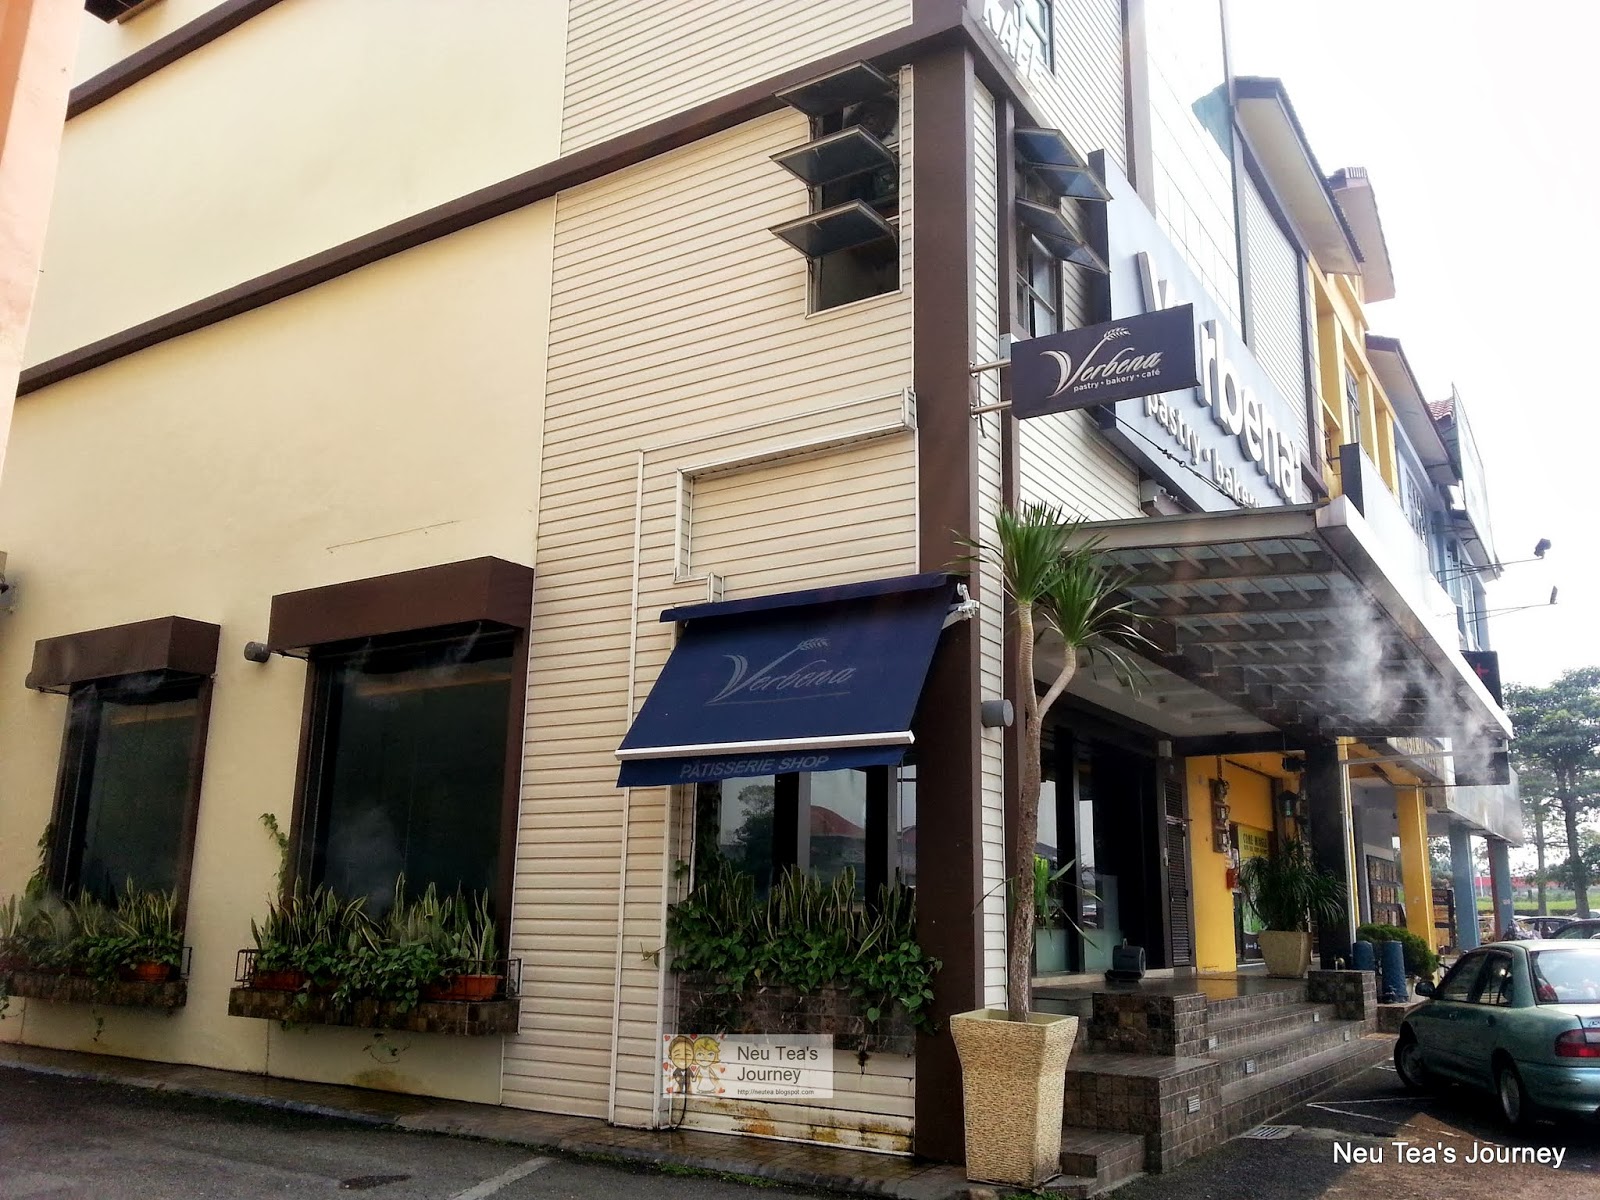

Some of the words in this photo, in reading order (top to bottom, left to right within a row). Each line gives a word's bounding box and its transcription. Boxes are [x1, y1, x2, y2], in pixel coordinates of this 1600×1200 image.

[1040, 328, 1163, 398] Verbena
[1073, 381, 1099, 392] pastry
[1106, 374, 1135, 386] bakery
[1141, 368, 1161, 379] café
[1143, 394, 1201, 466] pastry
[704, 638, 857, 704] Verbena
[778, 755, 829, 770] SHOP
